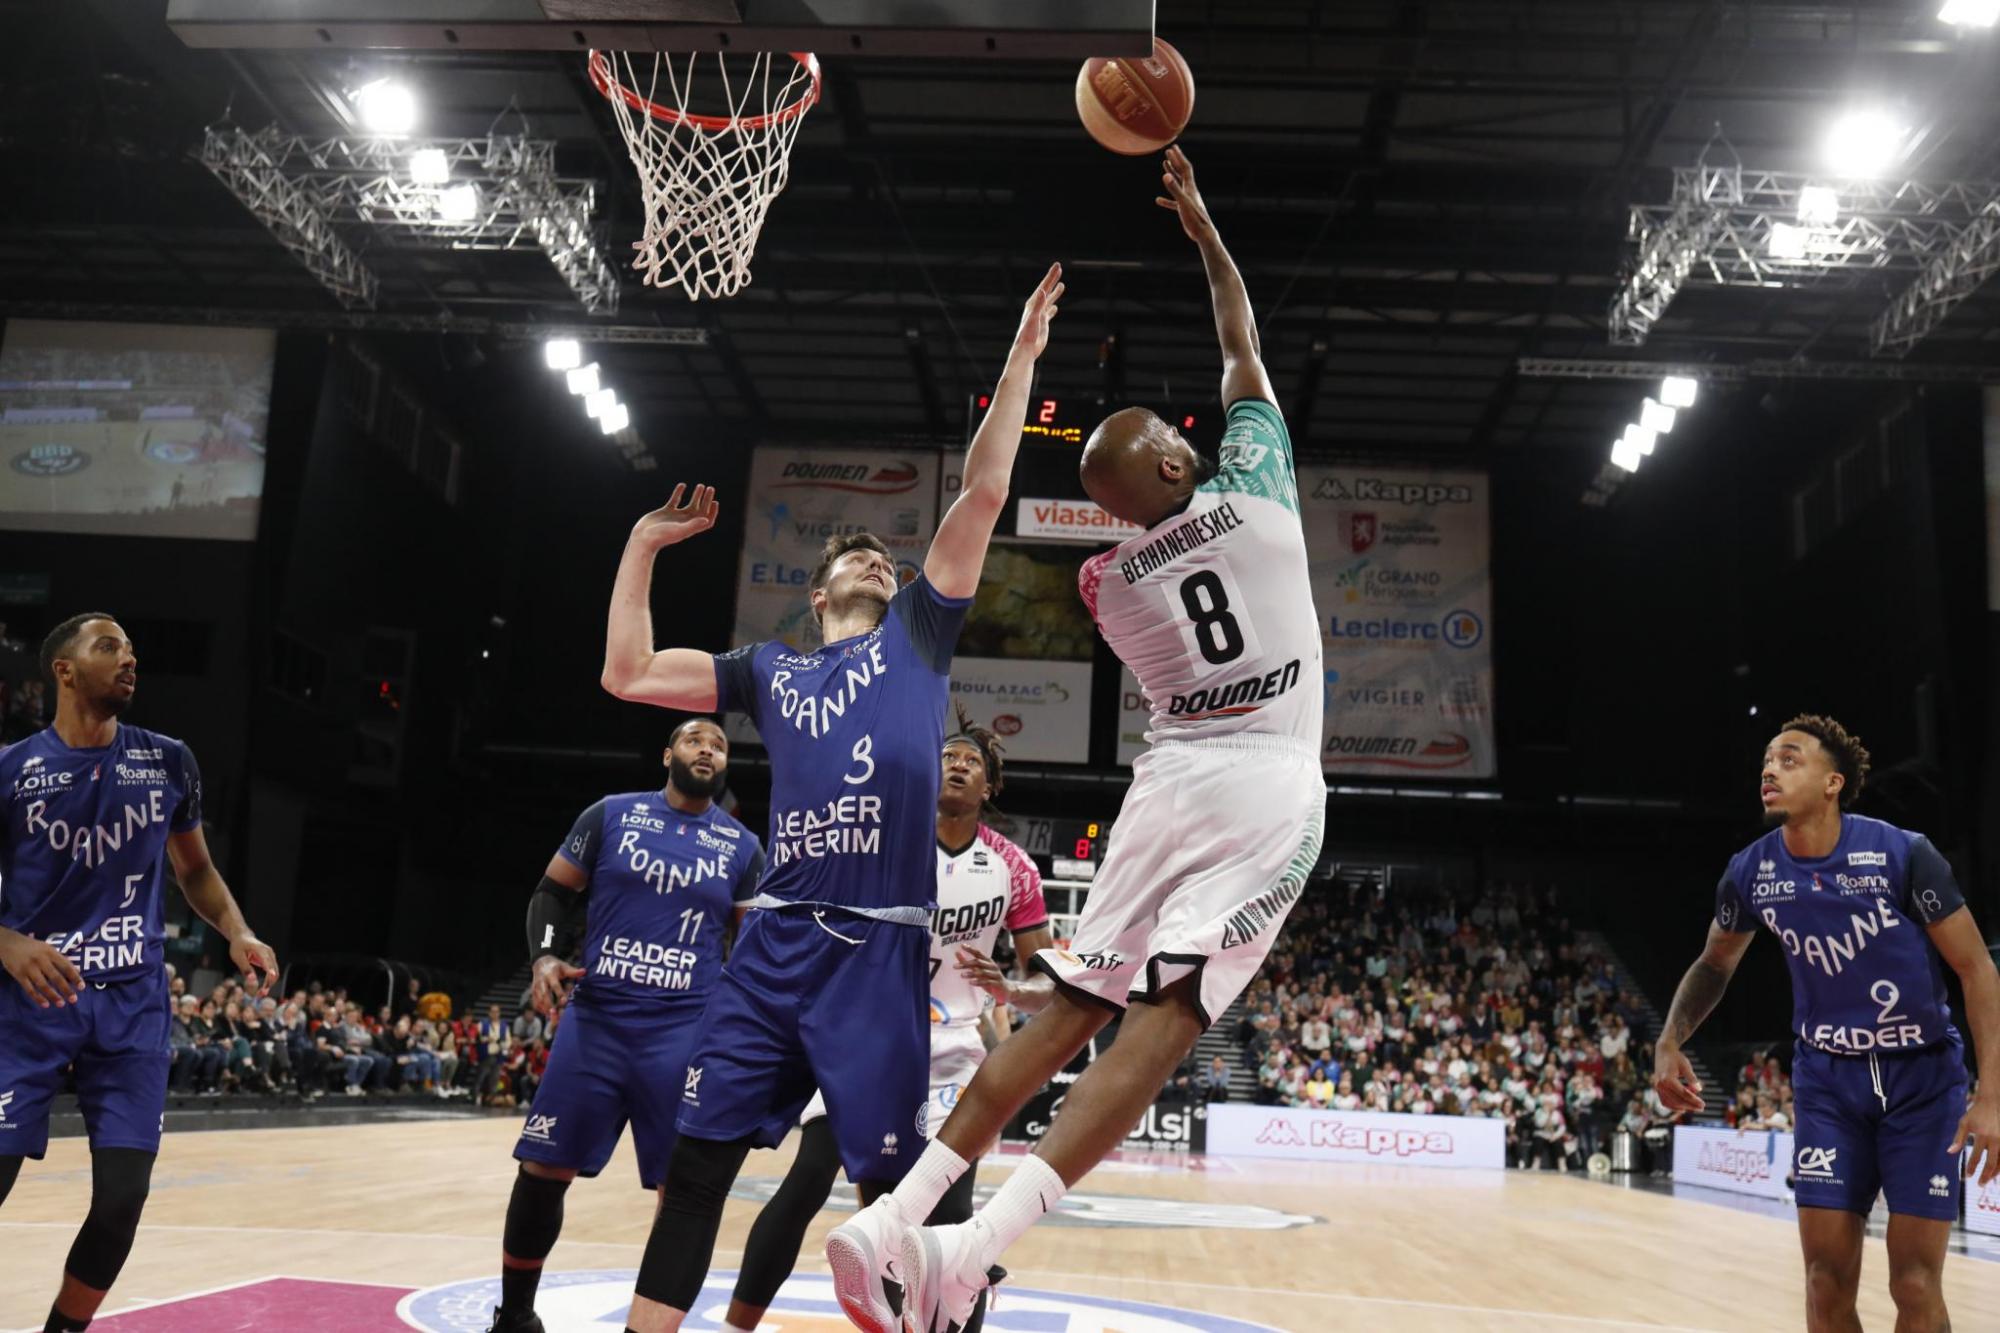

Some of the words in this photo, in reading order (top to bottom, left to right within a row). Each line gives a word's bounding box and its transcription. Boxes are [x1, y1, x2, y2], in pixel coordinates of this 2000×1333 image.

[1039, 400, 1056, 422] 2
[782, 462, 870, 482] DOUMEN
[1356, 478, 1472, 505] Kappa
[1121, 502, 1244, 586] BERHANEMESKEL
[1377, 570, 1440, 585] GRAND
[1180, 569, 1245, 665] 8
[770, 641, 887, 739] ROANNE
[1168, 658, 1301, 715] DOUMEN
[1350, 689, 1425, 706] VIGIER
[844, 733, 875, 785] 3
[1326, 735, 1417, 756] DOUMEN
[26, 790, 165, 869] ROANNE
[621, 812, 665, 830] Loire
[777, 795, 883, 837] LEADER
[1087, 822, 1098, 838] 8
[617, 830, 730, 895] ROANNE
[1075, 838, 1091, 859] 8
[119, 874, 144, 908] 5
[678, 908, 704, 945] 11
[930, 895, 1005, 937] IGORD
[601, 935, 697, 970] LEADER
[1762, 898, 1900, 977] ROANNE
[596, 956, 692, 990] INTERIM
[1870, 979, 1908, 1024] 2
[1801, 1022, 1925, 1050] LEADER
[1311, 1119, 1453, 1156] Kappa
[1715, 1141, 1770, 1182] Kappa
